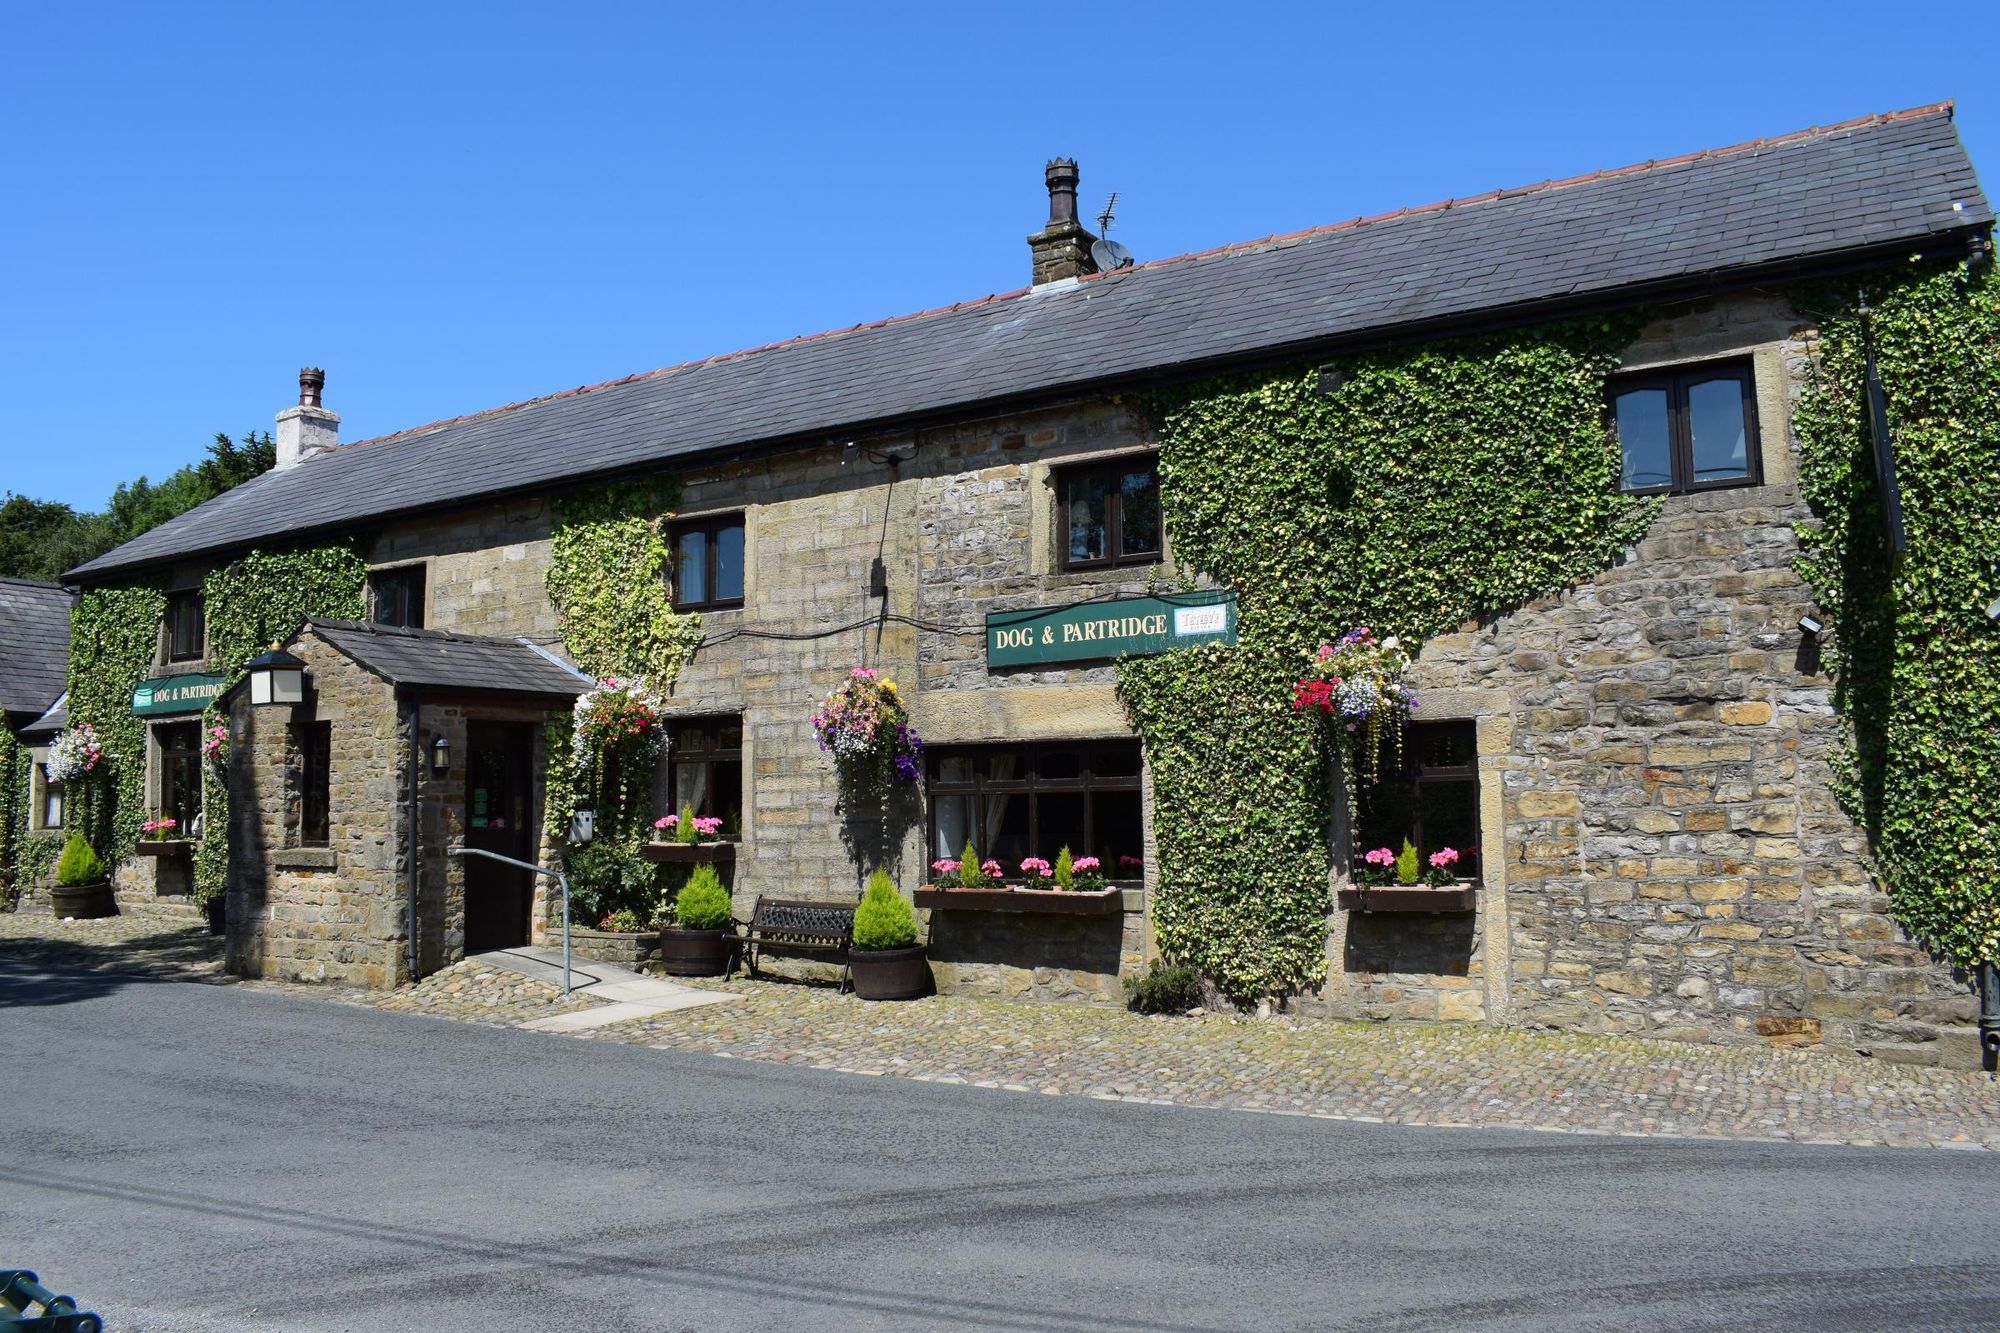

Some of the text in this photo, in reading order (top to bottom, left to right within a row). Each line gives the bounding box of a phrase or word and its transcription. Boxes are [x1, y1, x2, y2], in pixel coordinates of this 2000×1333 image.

[996, 614, 1168, 649] DOG & PARTRIDGE
[154, 689, 170, 703] DOG
[172, 688, 178, 700] &
